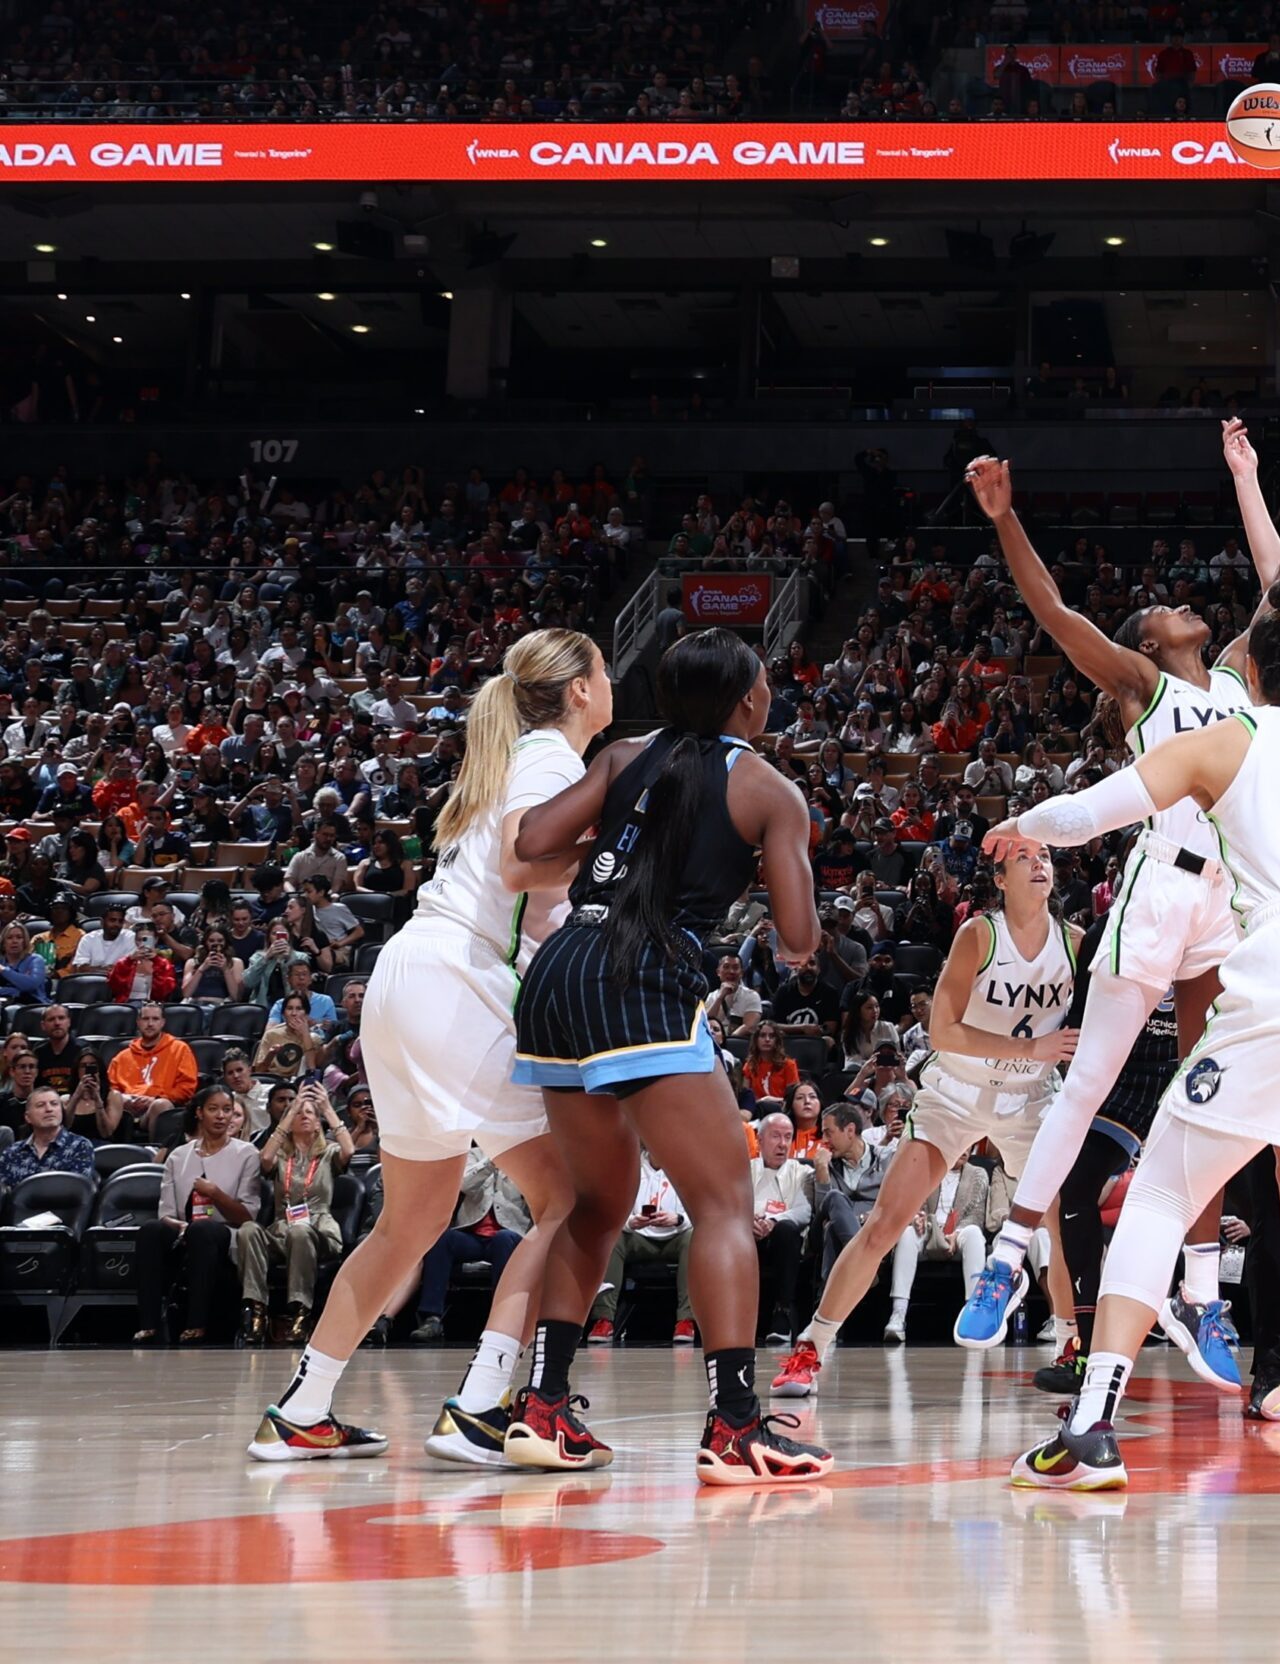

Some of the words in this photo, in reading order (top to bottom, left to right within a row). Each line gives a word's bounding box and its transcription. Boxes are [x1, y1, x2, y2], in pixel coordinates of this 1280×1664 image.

[90, 143, 223, 167] GAME
[233, 150, 258, 158] Presented
[268, 149, 309, 160] Tangerine
[475, 149, 519, 158] WNBA
[530, 141, 719, 166] CANADA
[733, 141, 865, 165] GAME
[876, 149, 901, 157] Presented
[910, 147, 950, 158] Tangerine
[1117, 148, 1161, 157] WNBA
[250, 440, 299, 464] 107
[701, 594, 758, 603] CANADA
[701, 602, 739, 610] GAME
[986, 980, 1064, 1008] LYNX
[1010, 1014, 1033, 1039] 6
[1146, 1019, 1178, 1029] UChica
[985, 1057, 1039, 1075] CLINIC
